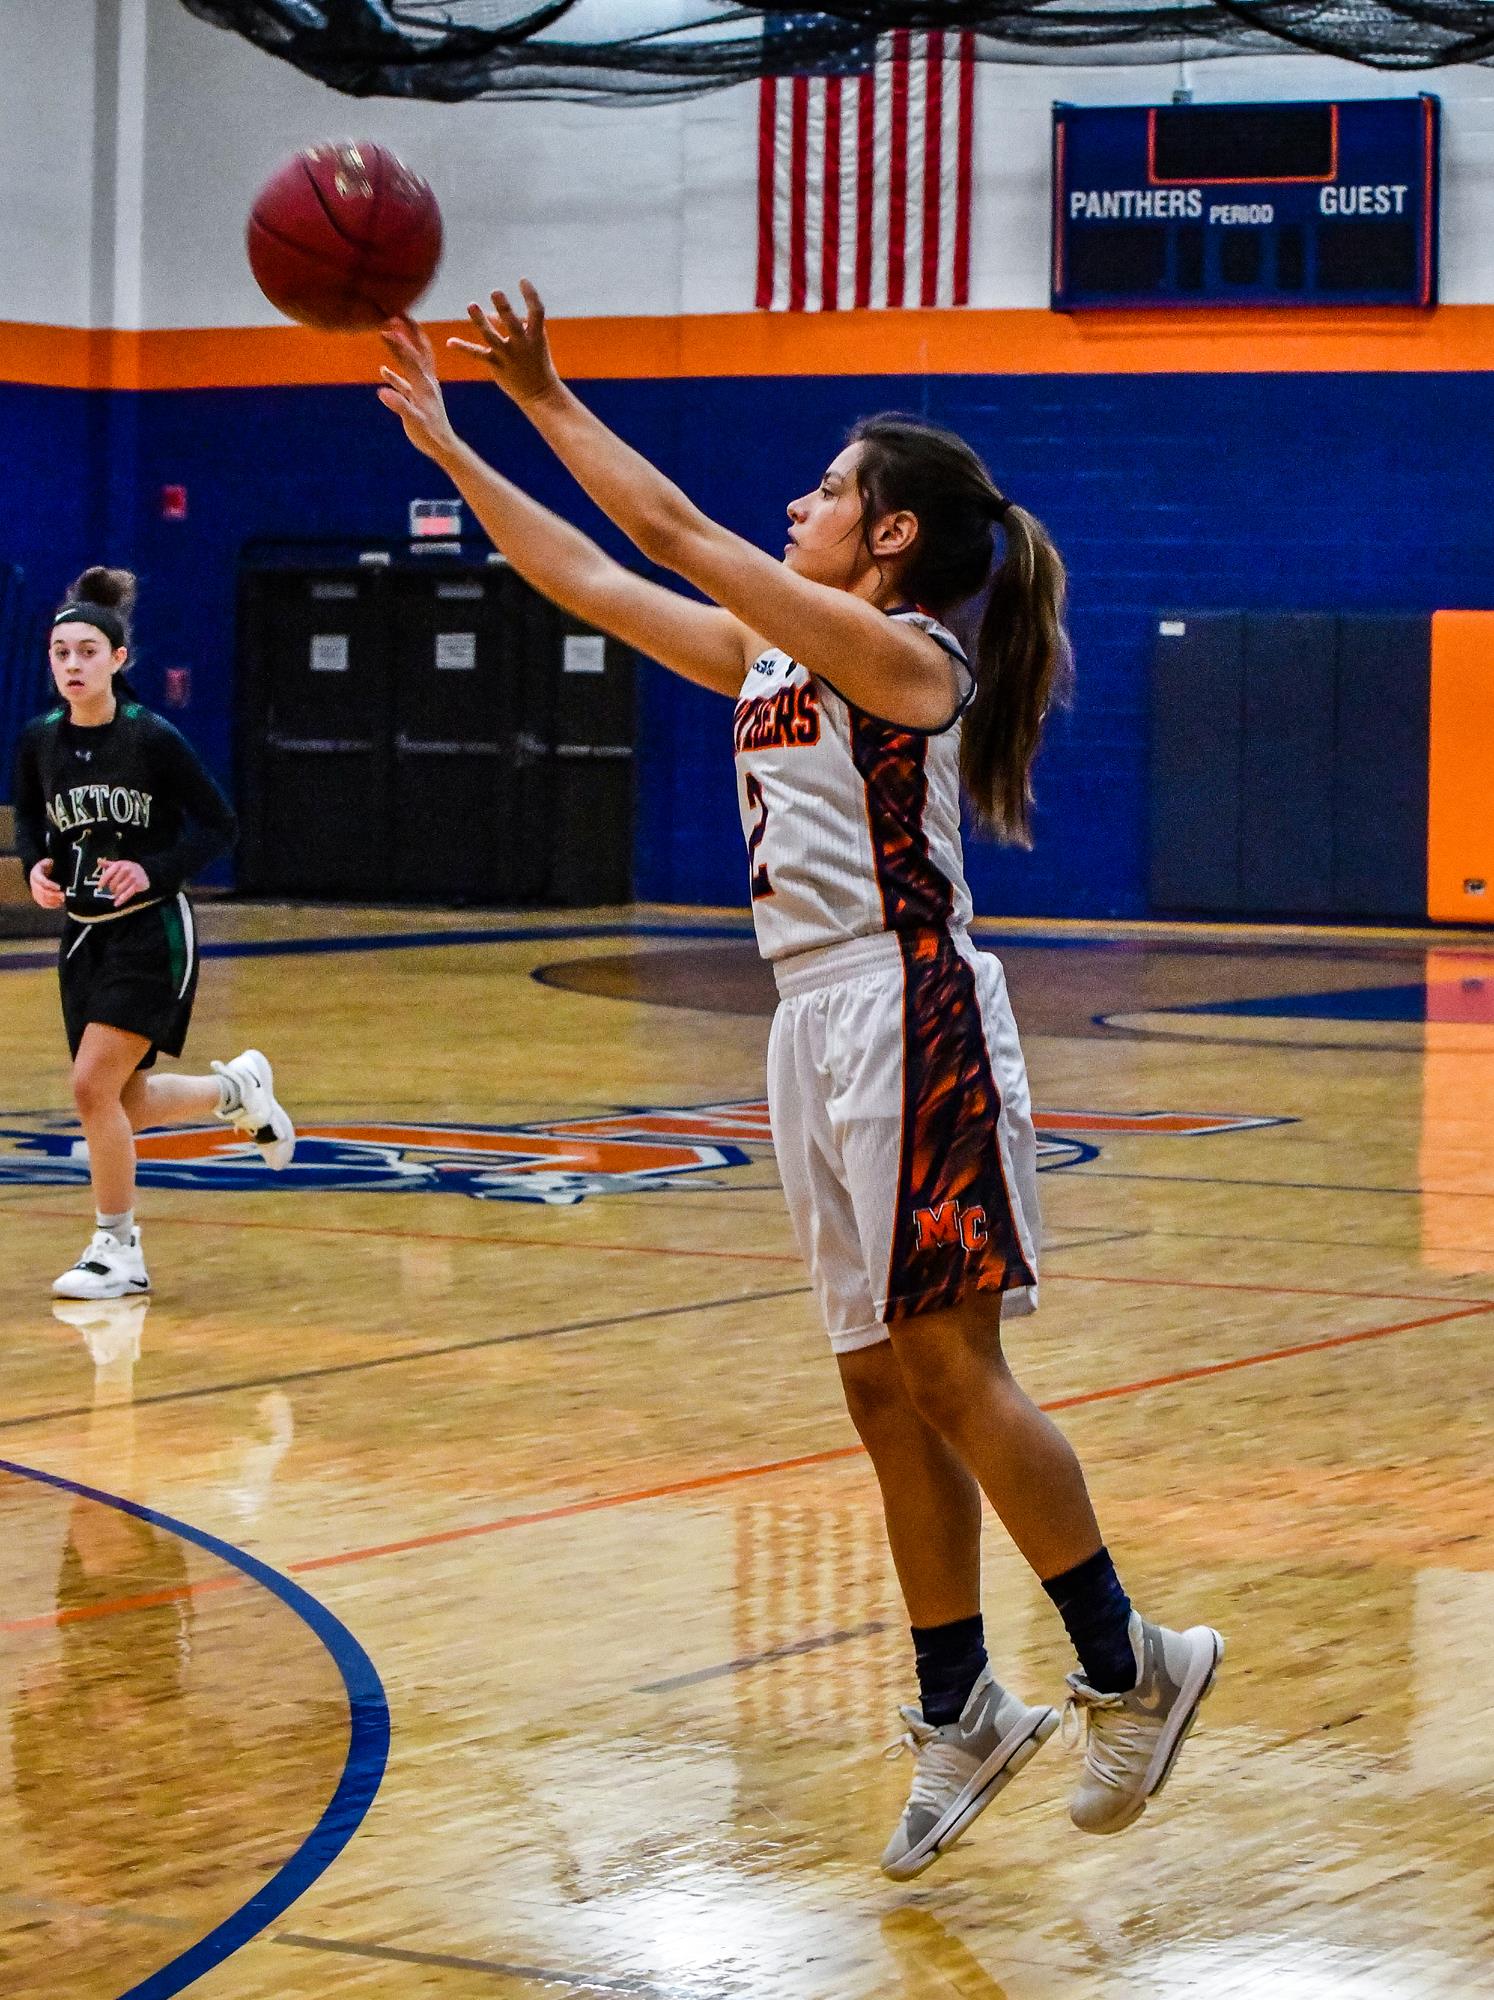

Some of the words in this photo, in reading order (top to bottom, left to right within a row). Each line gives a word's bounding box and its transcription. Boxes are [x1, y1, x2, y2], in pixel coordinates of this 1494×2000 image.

[1070, 188, 1202, 219] PANTHERS
[1209, 204, 1274, 225] PERIOD
[1319, 185, 1409, 216] GUEST
[912, 1199, 989, 1251] MC
